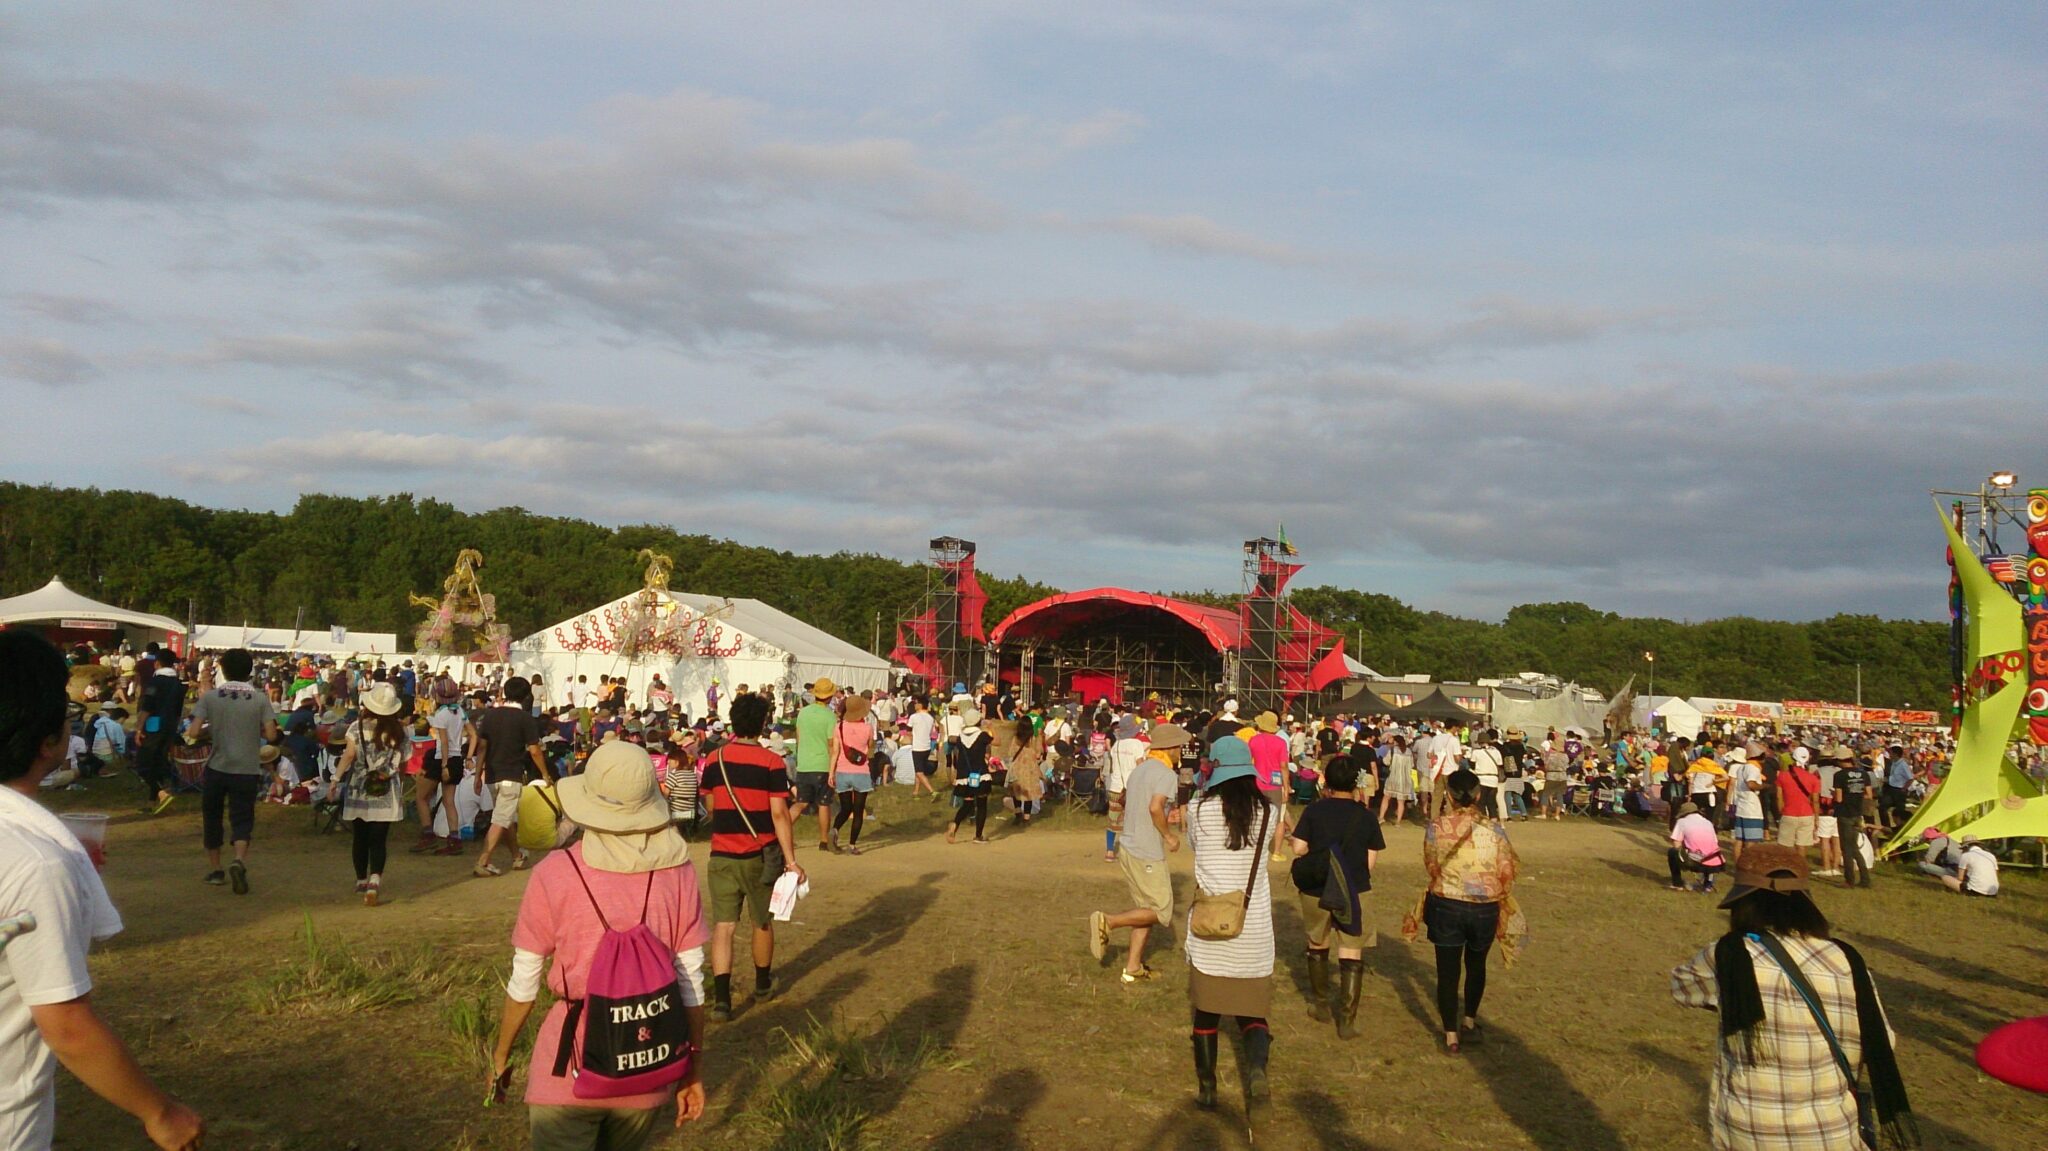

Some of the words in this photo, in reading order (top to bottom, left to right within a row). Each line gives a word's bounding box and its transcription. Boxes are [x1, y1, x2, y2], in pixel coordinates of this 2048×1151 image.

[610, 994, 670, 1024] TRACK
[637, 1026, 652, 1042] &
[616, 1043, 670, 1071] FIELD
